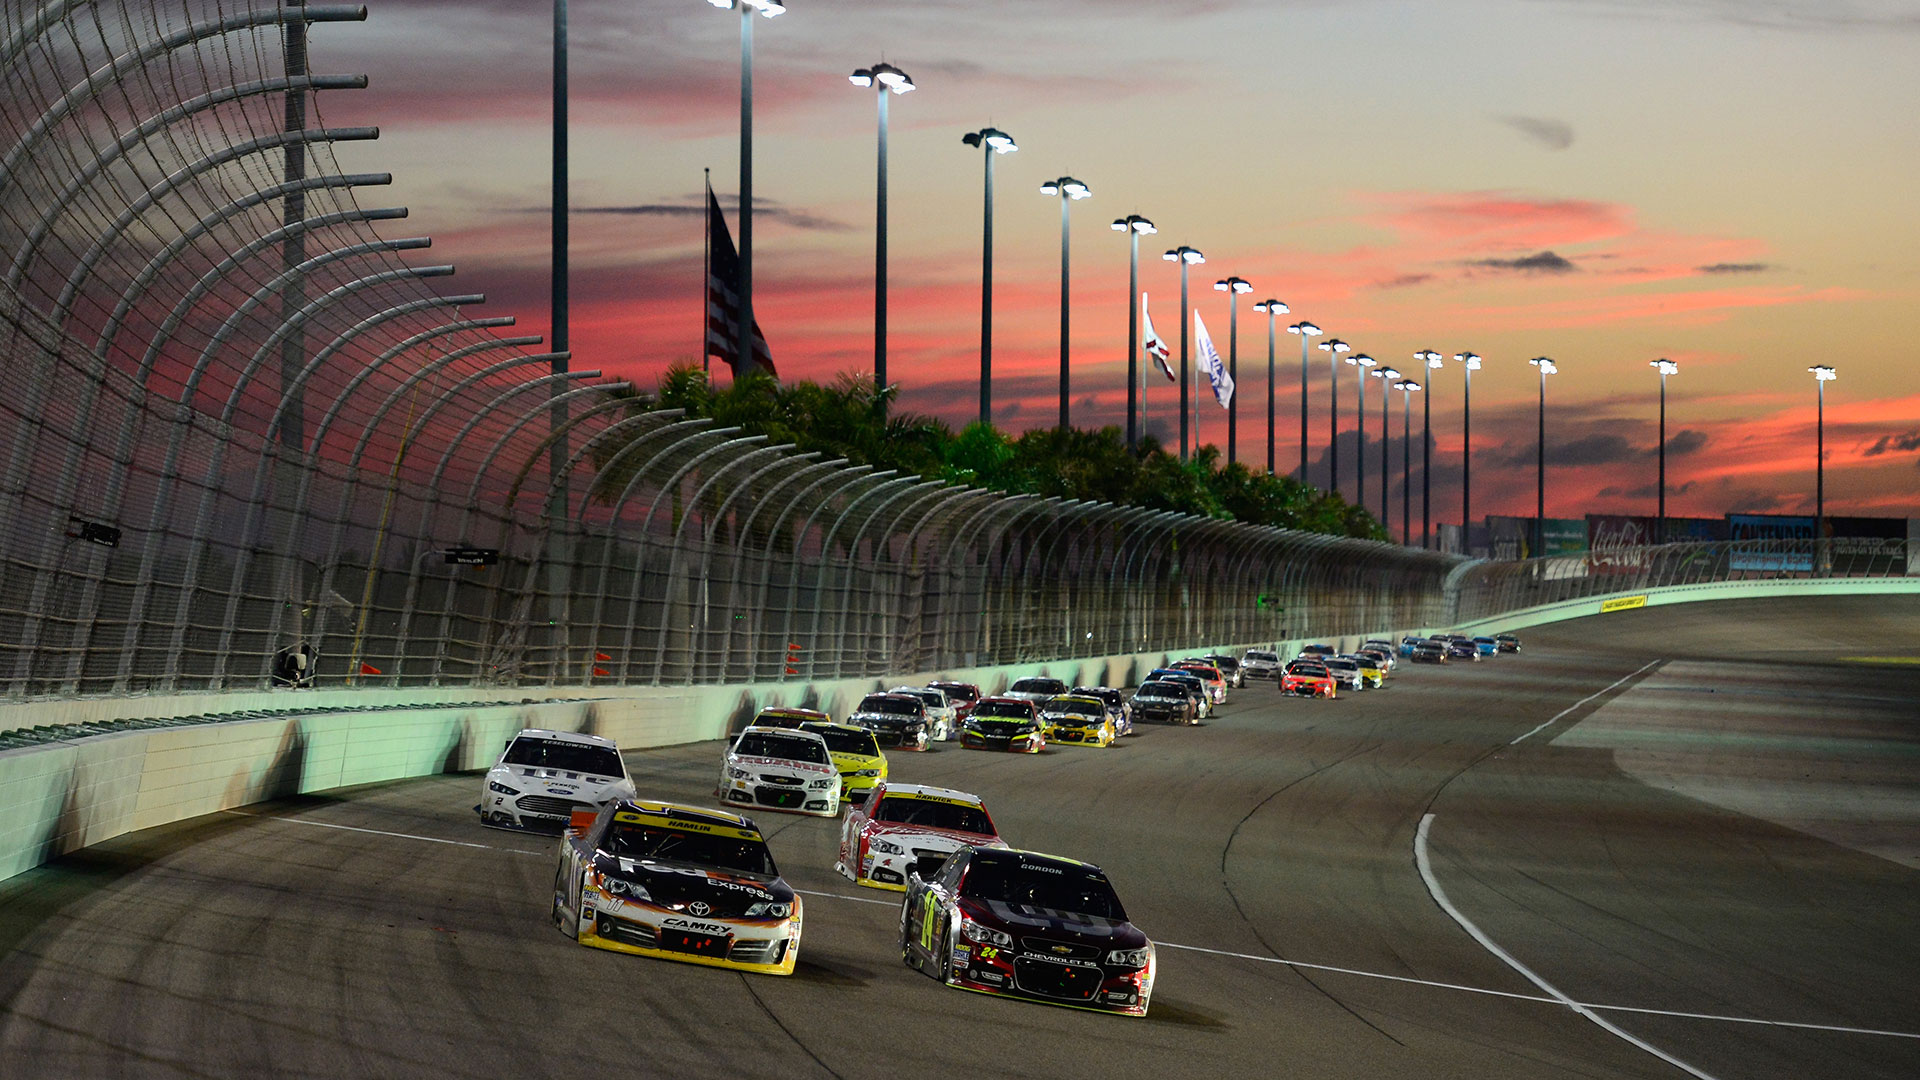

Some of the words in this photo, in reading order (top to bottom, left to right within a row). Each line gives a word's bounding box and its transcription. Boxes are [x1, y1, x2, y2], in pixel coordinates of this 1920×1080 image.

[1732, 522, 1812, 553] CONTENDER
[542, 739, 592, 750] KESELOWSKI
[494, 796, 504, 806] 2
[915, 793, 953, 804] HARVICK
[667, 820, 711, 832] HAMLIN
[1020, 863, 1064, 875] GORDON
[707, 878, 774, 901] Express
[606, 897, 625, 913] 11
[663, 918, 732, 934] CAMRY
[980, 946, 999, 959] 24
[1023, 951, 1082, 966] CHEVROLET
[1083, 960, 1097, 968] SS
